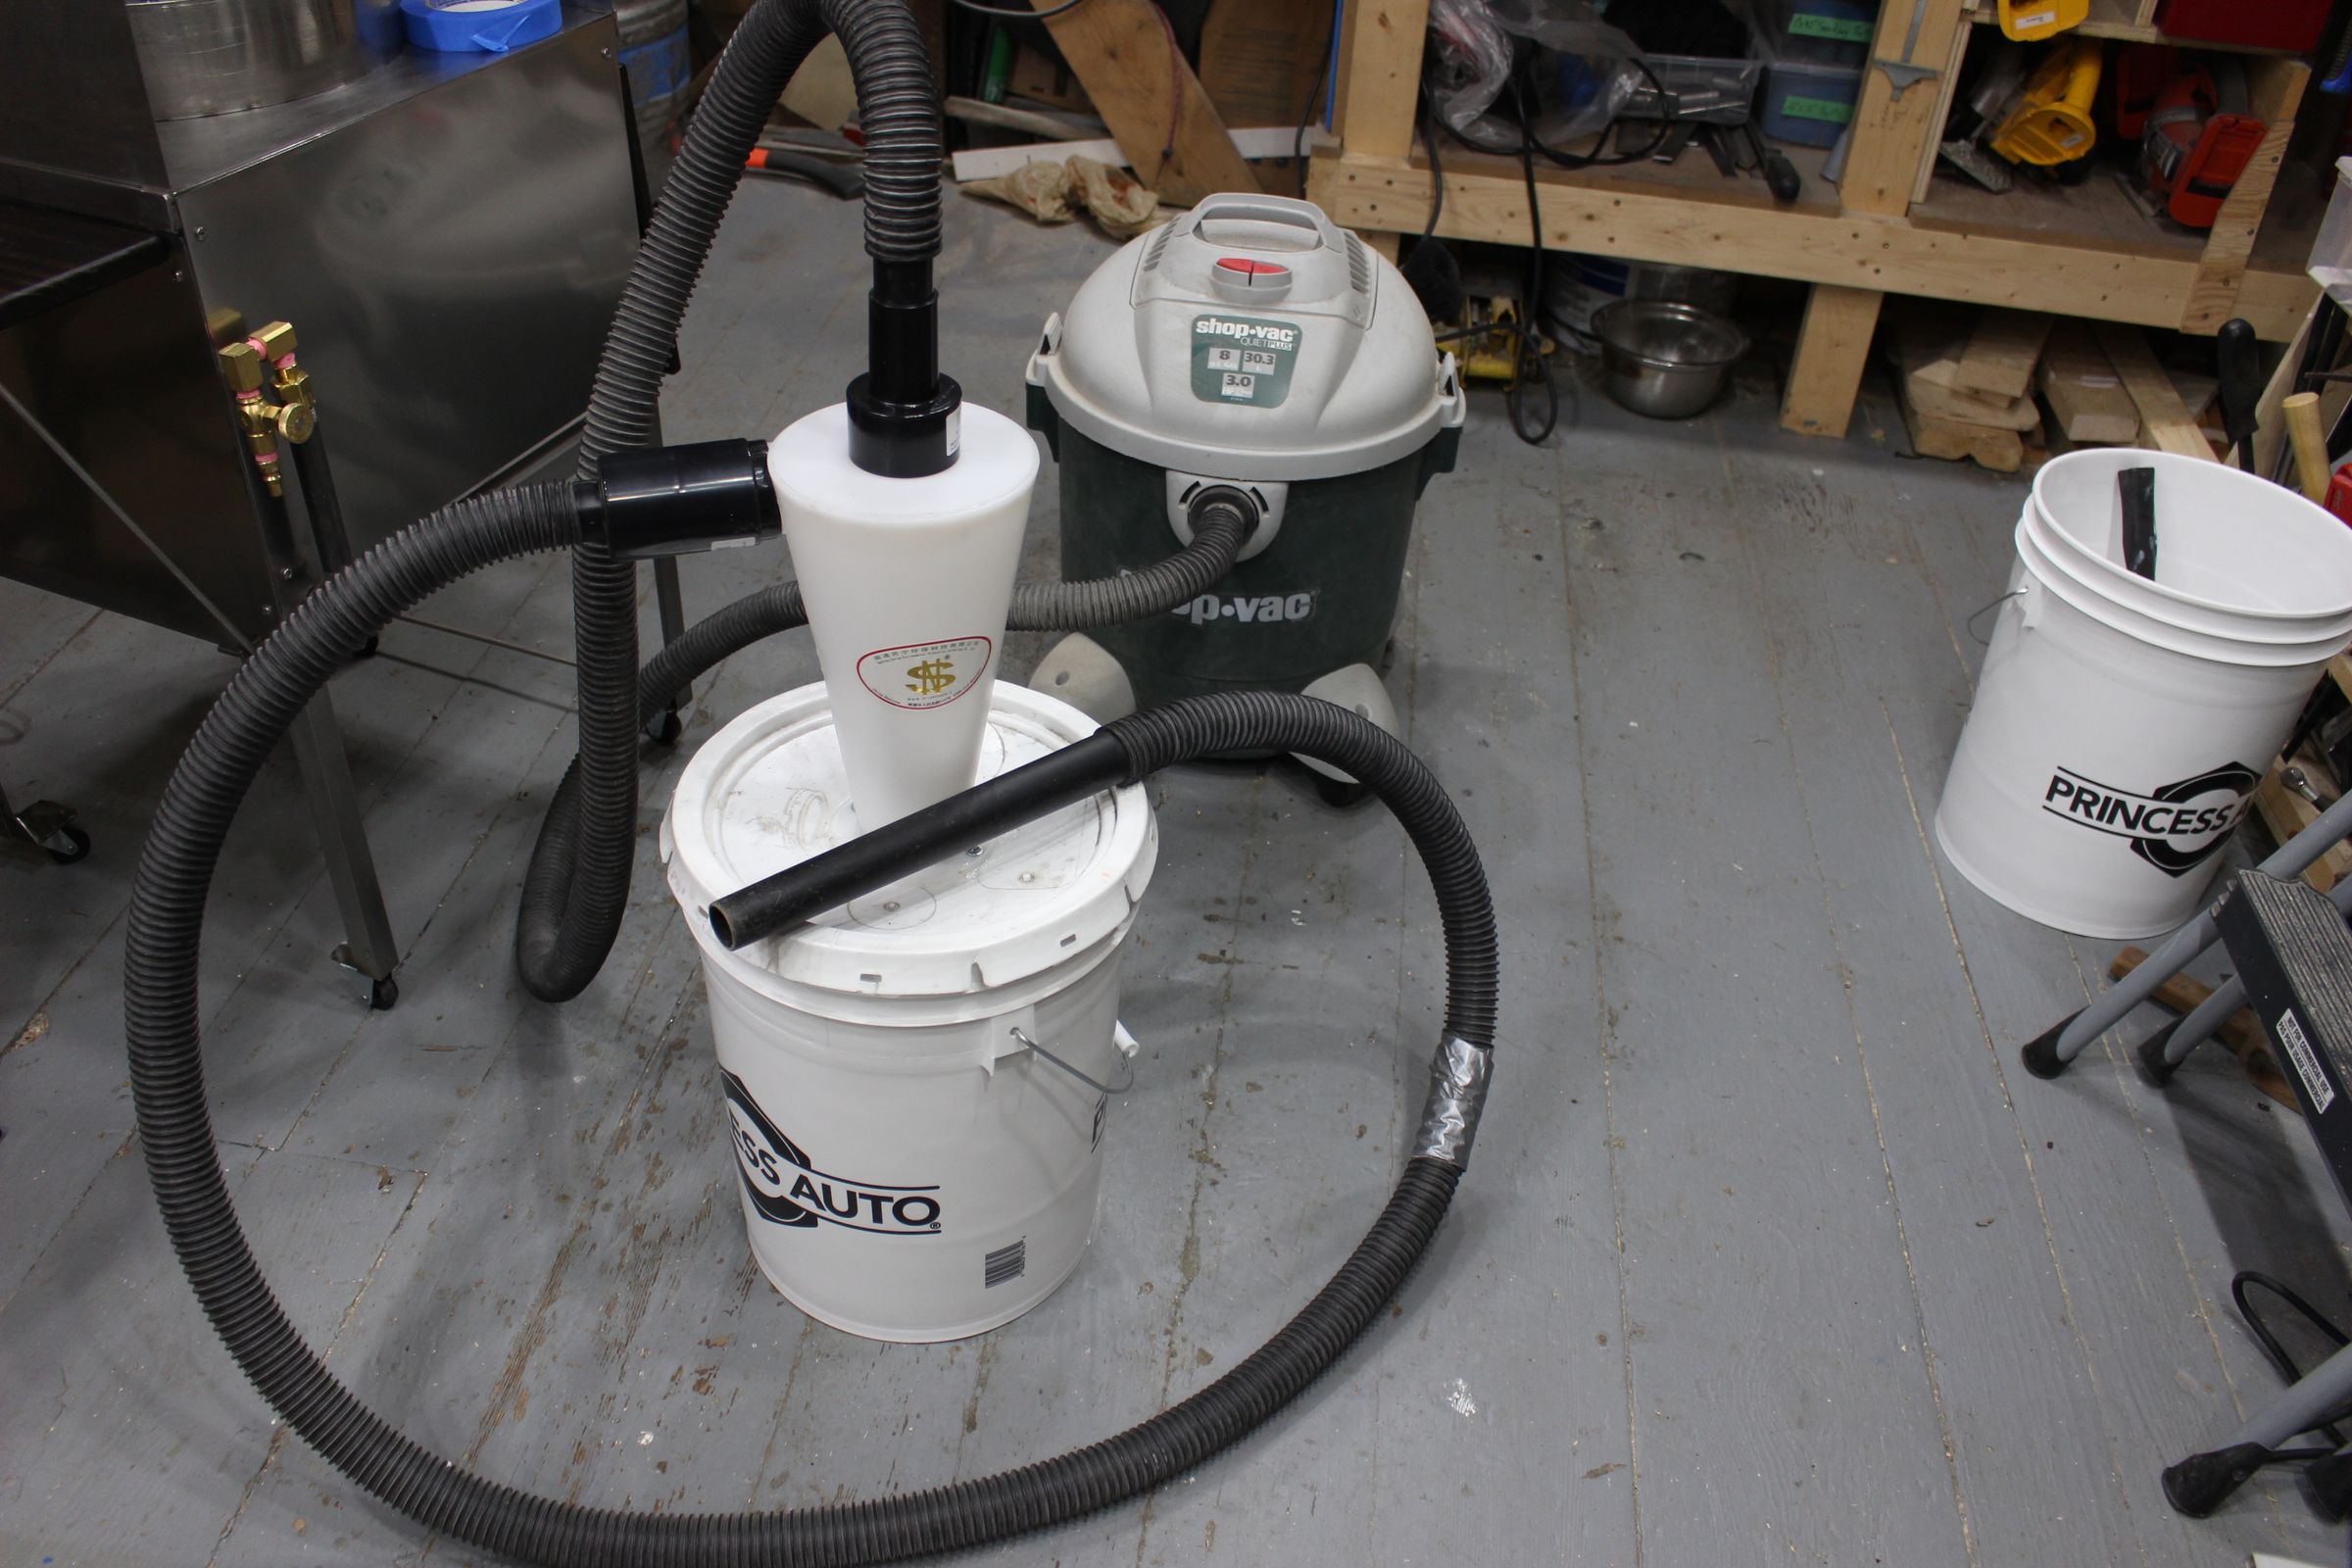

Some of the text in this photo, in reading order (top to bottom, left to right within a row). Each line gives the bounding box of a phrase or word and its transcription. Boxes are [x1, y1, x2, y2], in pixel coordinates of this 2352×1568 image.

[1219, 350, 1231, 361] 8
[1245, 352, 1274, 366] 30.3
[1226, 374, 1251, 387] 3.0
[2045, 774, 2234, 835] PRINCESS
[790, 1173, 941, 1225] AUTO
